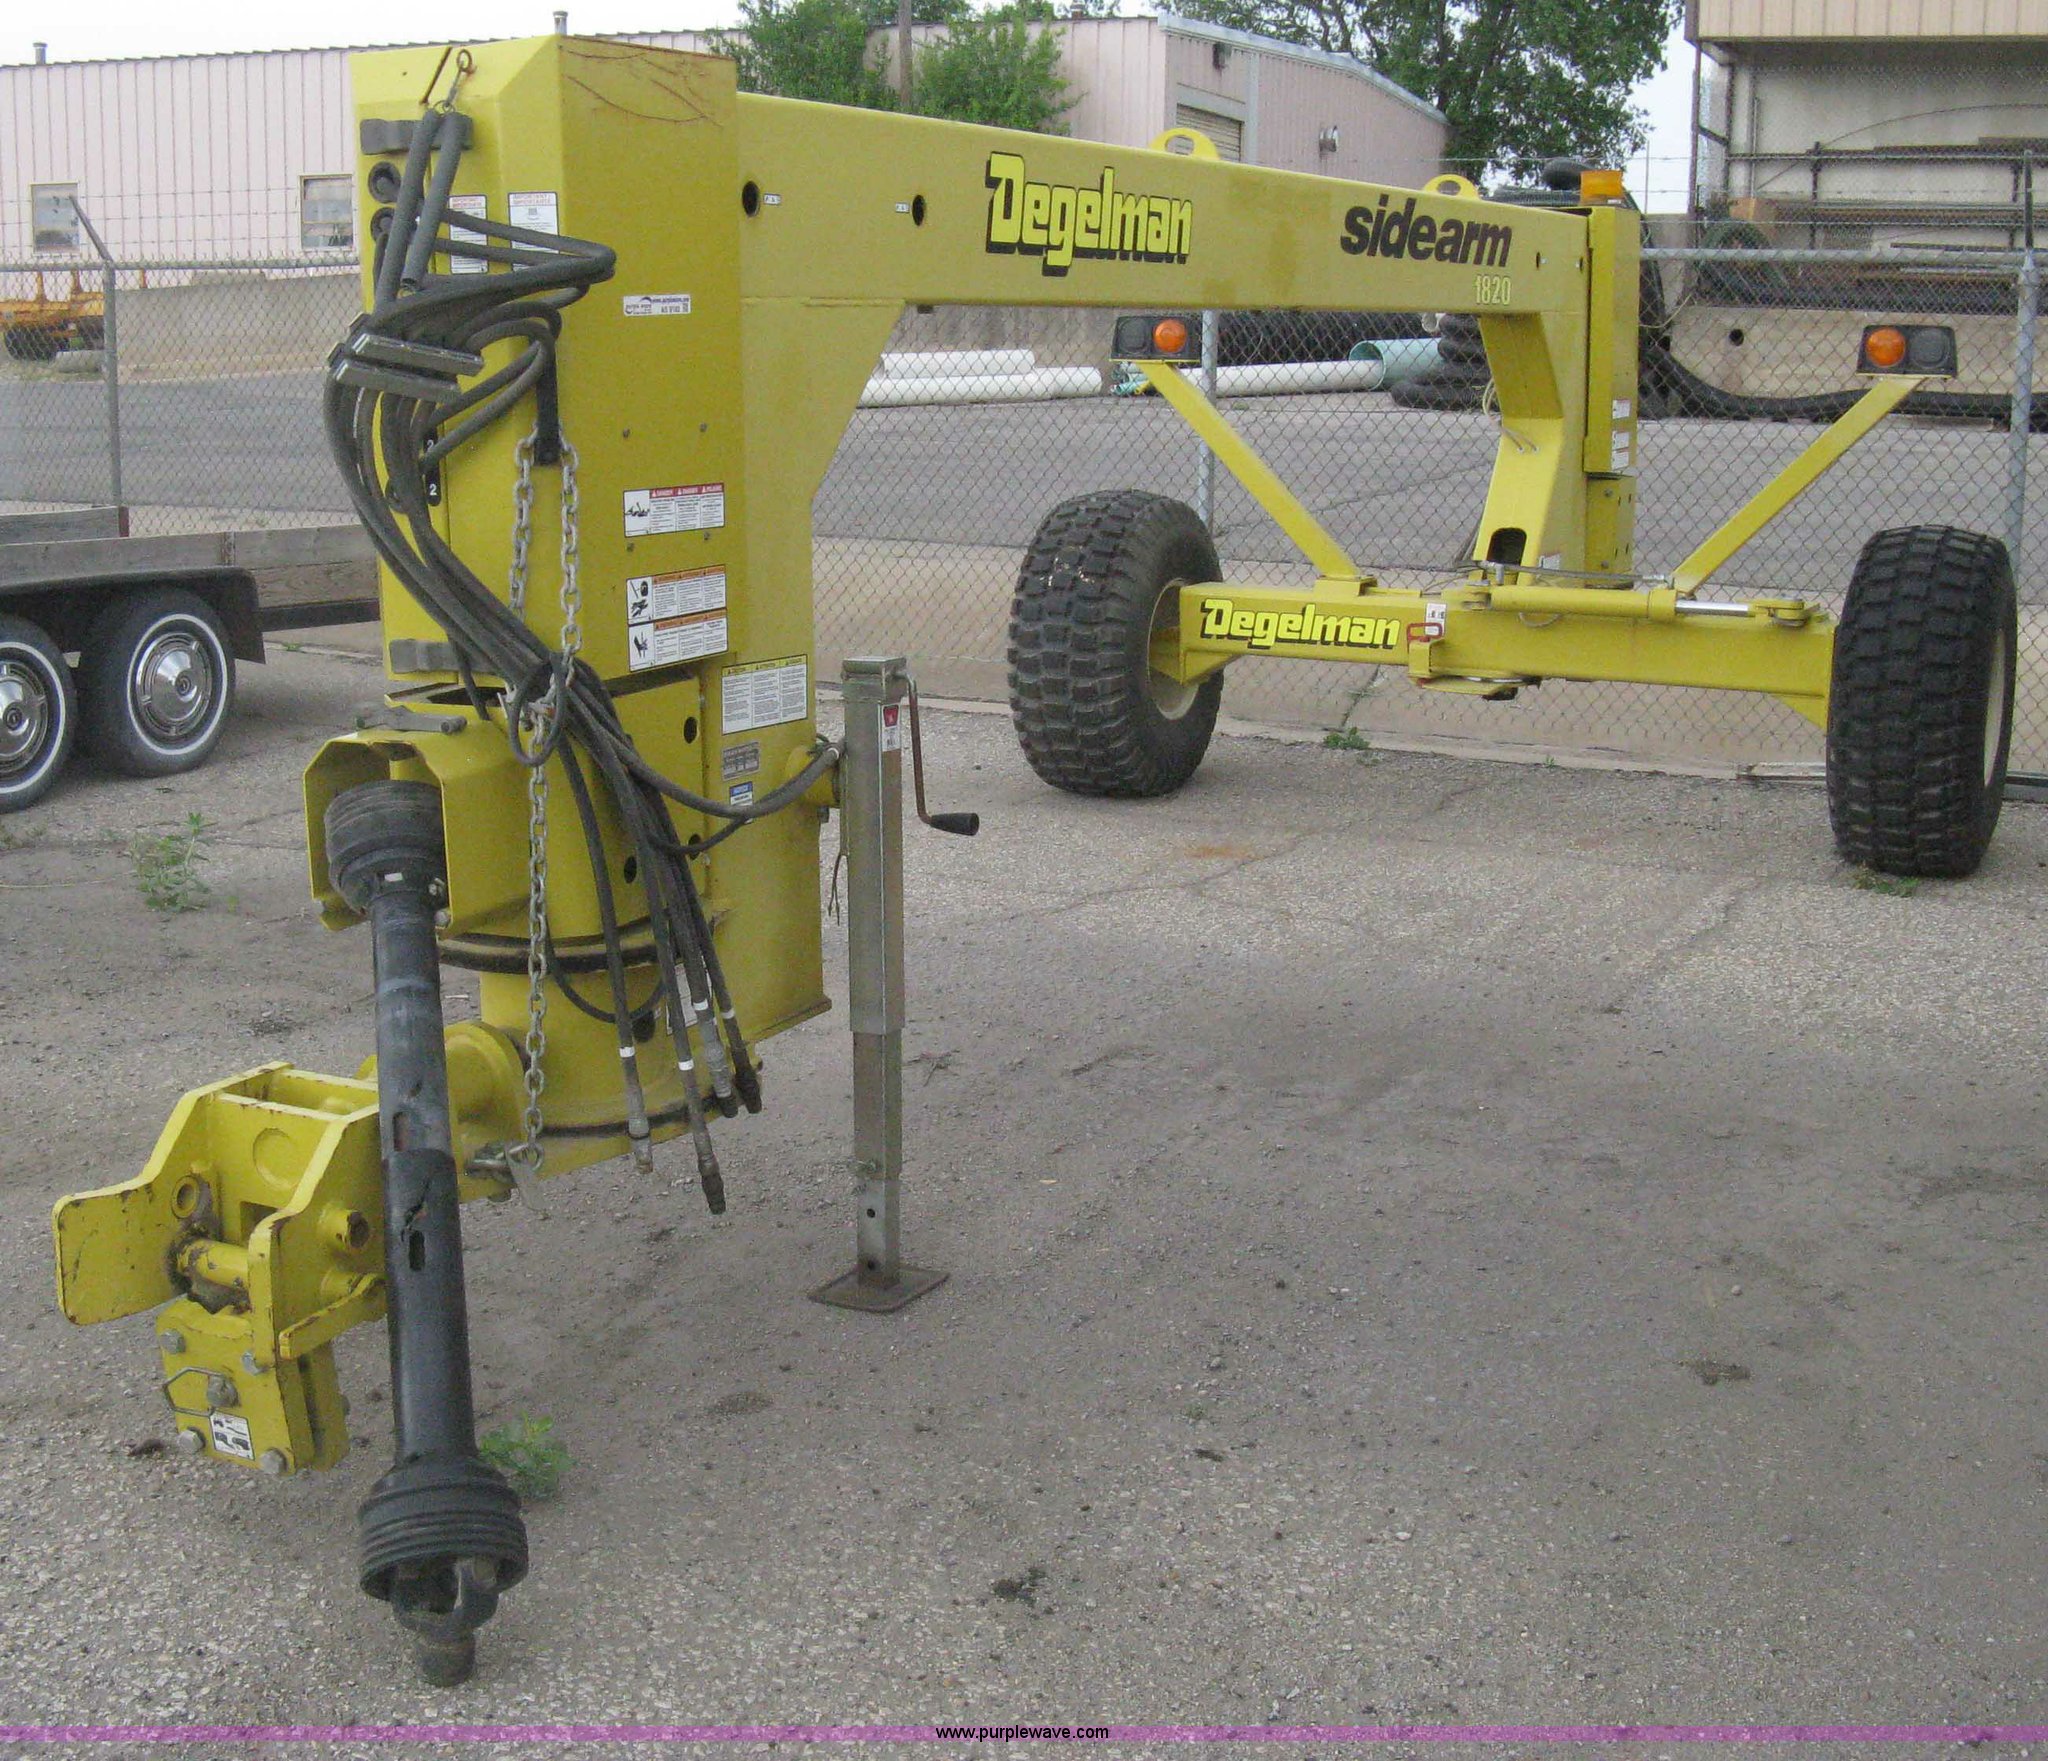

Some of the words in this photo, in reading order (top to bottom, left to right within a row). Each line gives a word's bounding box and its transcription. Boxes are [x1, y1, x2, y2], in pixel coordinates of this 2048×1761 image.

[985, 151, 1193, 277] Degelman
[1340, 193, 1512, 267] sidearm
[1474, 275, 1511, 305] 1820
[429, 483, 437, 496] 2
[1200, 598, 1401, 650] Degelman
